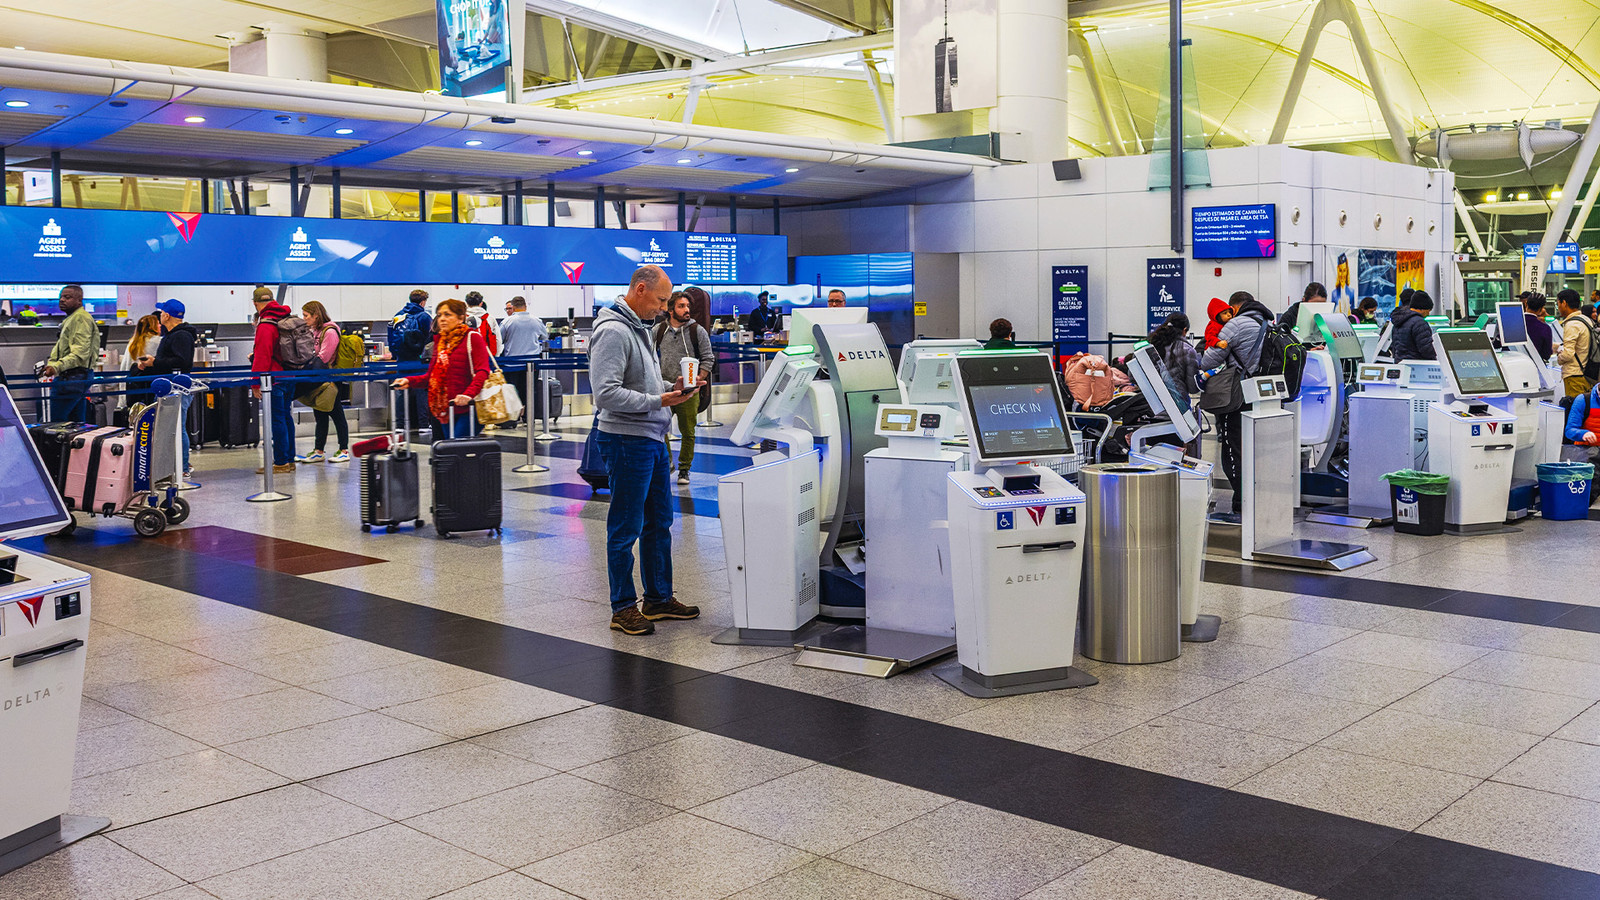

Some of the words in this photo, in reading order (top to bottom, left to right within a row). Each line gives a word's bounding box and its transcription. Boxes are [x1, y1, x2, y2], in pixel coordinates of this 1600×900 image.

[1398, 262, 1409, 273] NEW
[848, 350, 886, 360] DELTA
[1317, 394, 1324, 404] 4
[990, 403, 1028, 414] CHECK
[1029, 403, 1041, 413] IN
[138, 422, 150, 481] smartecarte
[4, 688, 50, 710] DELTA
